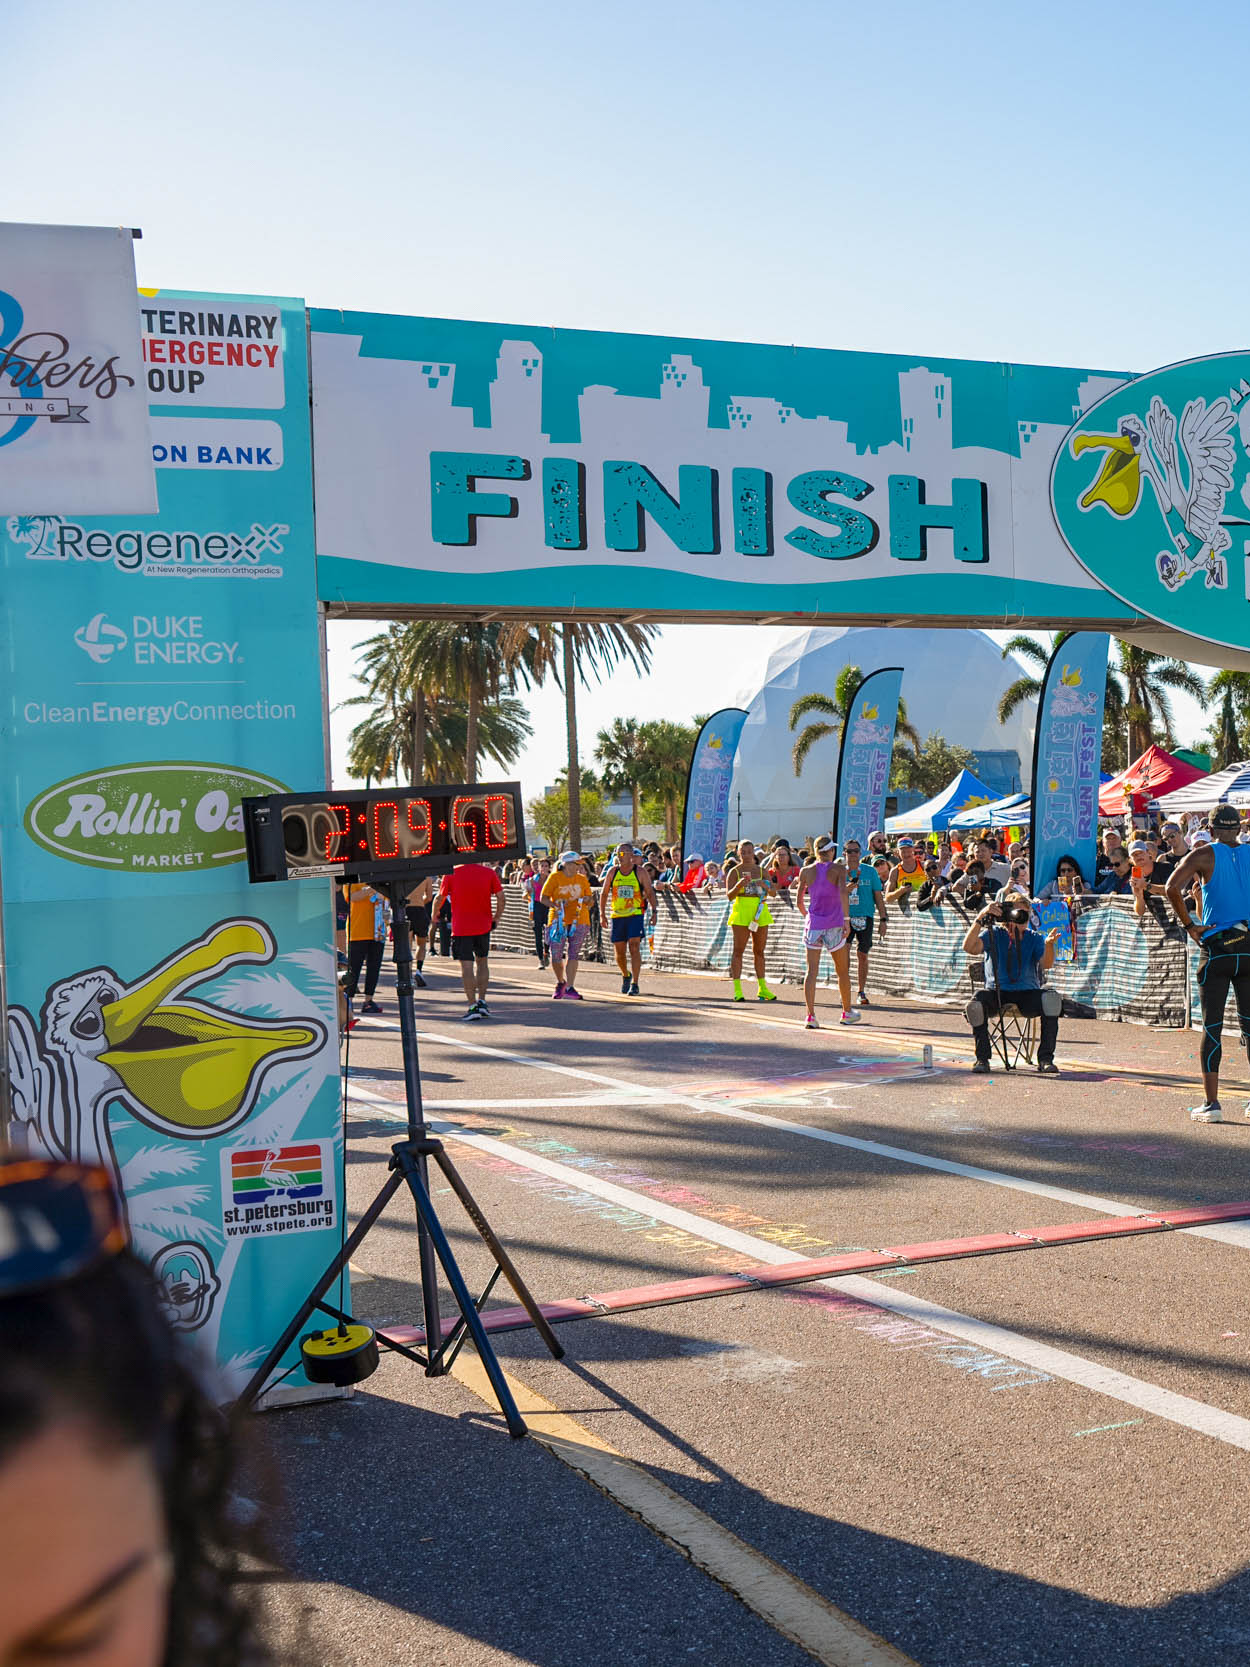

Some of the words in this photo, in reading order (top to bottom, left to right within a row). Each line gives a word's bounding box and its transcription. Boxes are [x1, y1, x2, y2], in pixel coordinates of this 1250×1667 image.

[142, 338, 279, 368] ERGENCY
[197, 446, 272, 465] BANK
[429, 451, 989, 562] FINISH
[157, 566, 174, 574] New
[176, 567, 231, 575] Regeneration
[231, 567, 280, 576] Orthopedics
[133, 616, 203, 638] DUKE
[134, 642, 239, 664] ENERGY
[24, 701, 297, 725] CleanEnergyConnection
[53, 794, 187, 838] Rollin'
[1077, 785, 1094, 839] RUN
[132, 852, 204, 867] MARKET
[224, 1199, 333, 1224] st.petersburg
[227, 1216, 332, 1236] www.stpete.org
